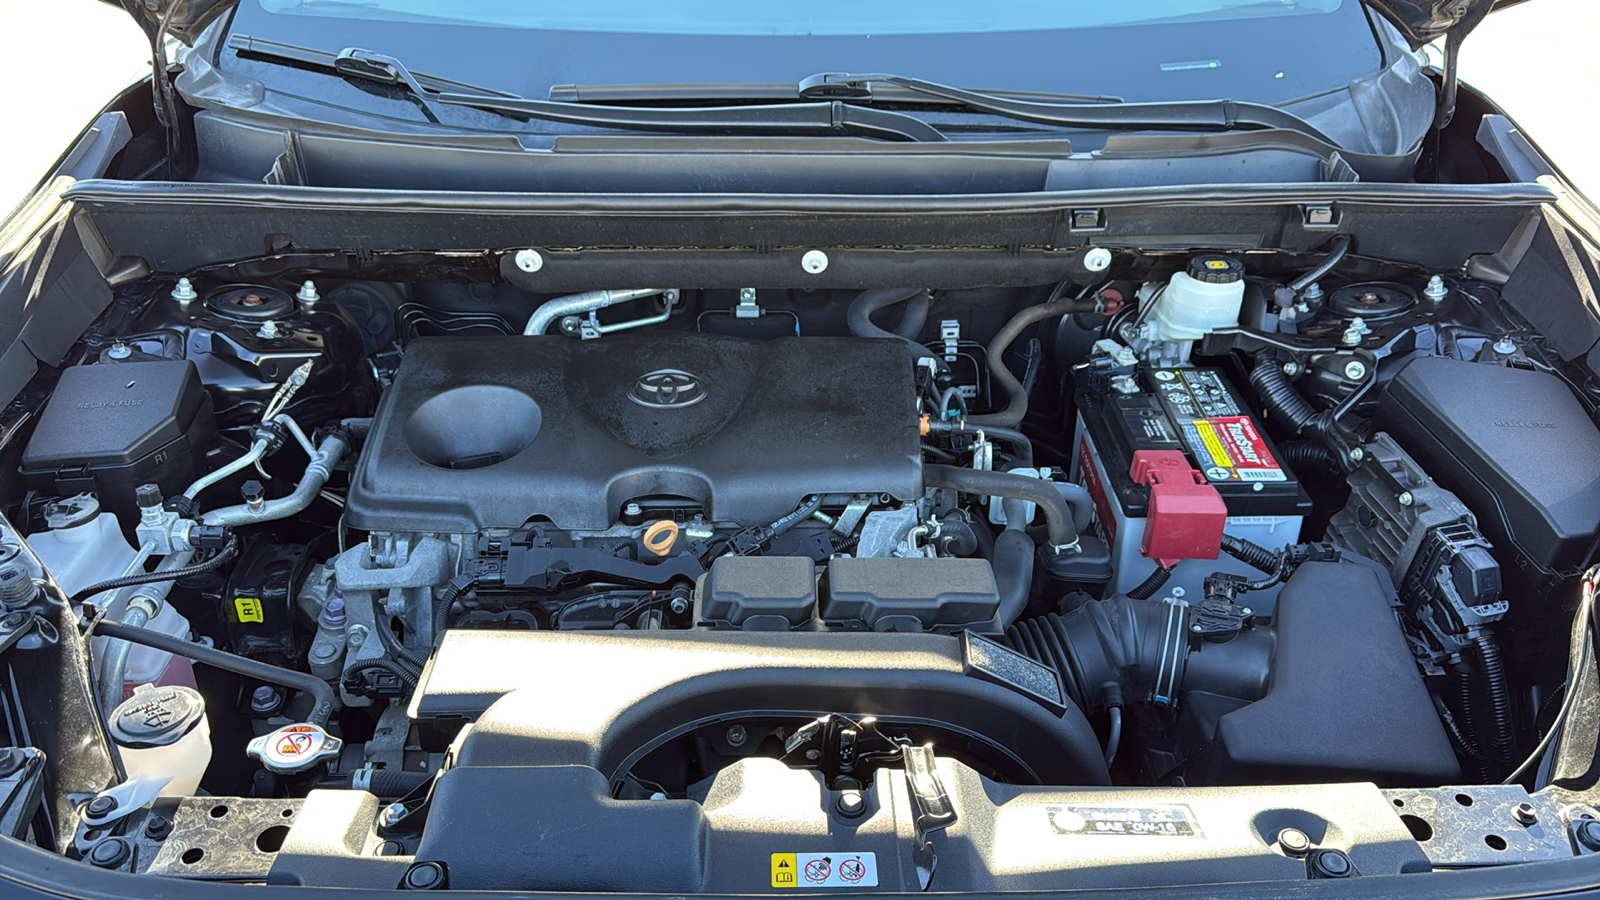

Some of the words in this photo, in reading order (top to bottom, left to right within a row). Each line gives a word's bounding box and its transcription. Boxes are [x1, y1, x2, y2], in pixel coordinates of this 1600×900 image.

[77, 401, 107, 410] RELAY
[118, 399, 144, 407] FUSE
[154, 450, 168, 465] R1
[241, 602, 254, 616] R1
[1090, 810, 1142, 821] ENGINE
[1095, 821, 1125, 832] SAE
